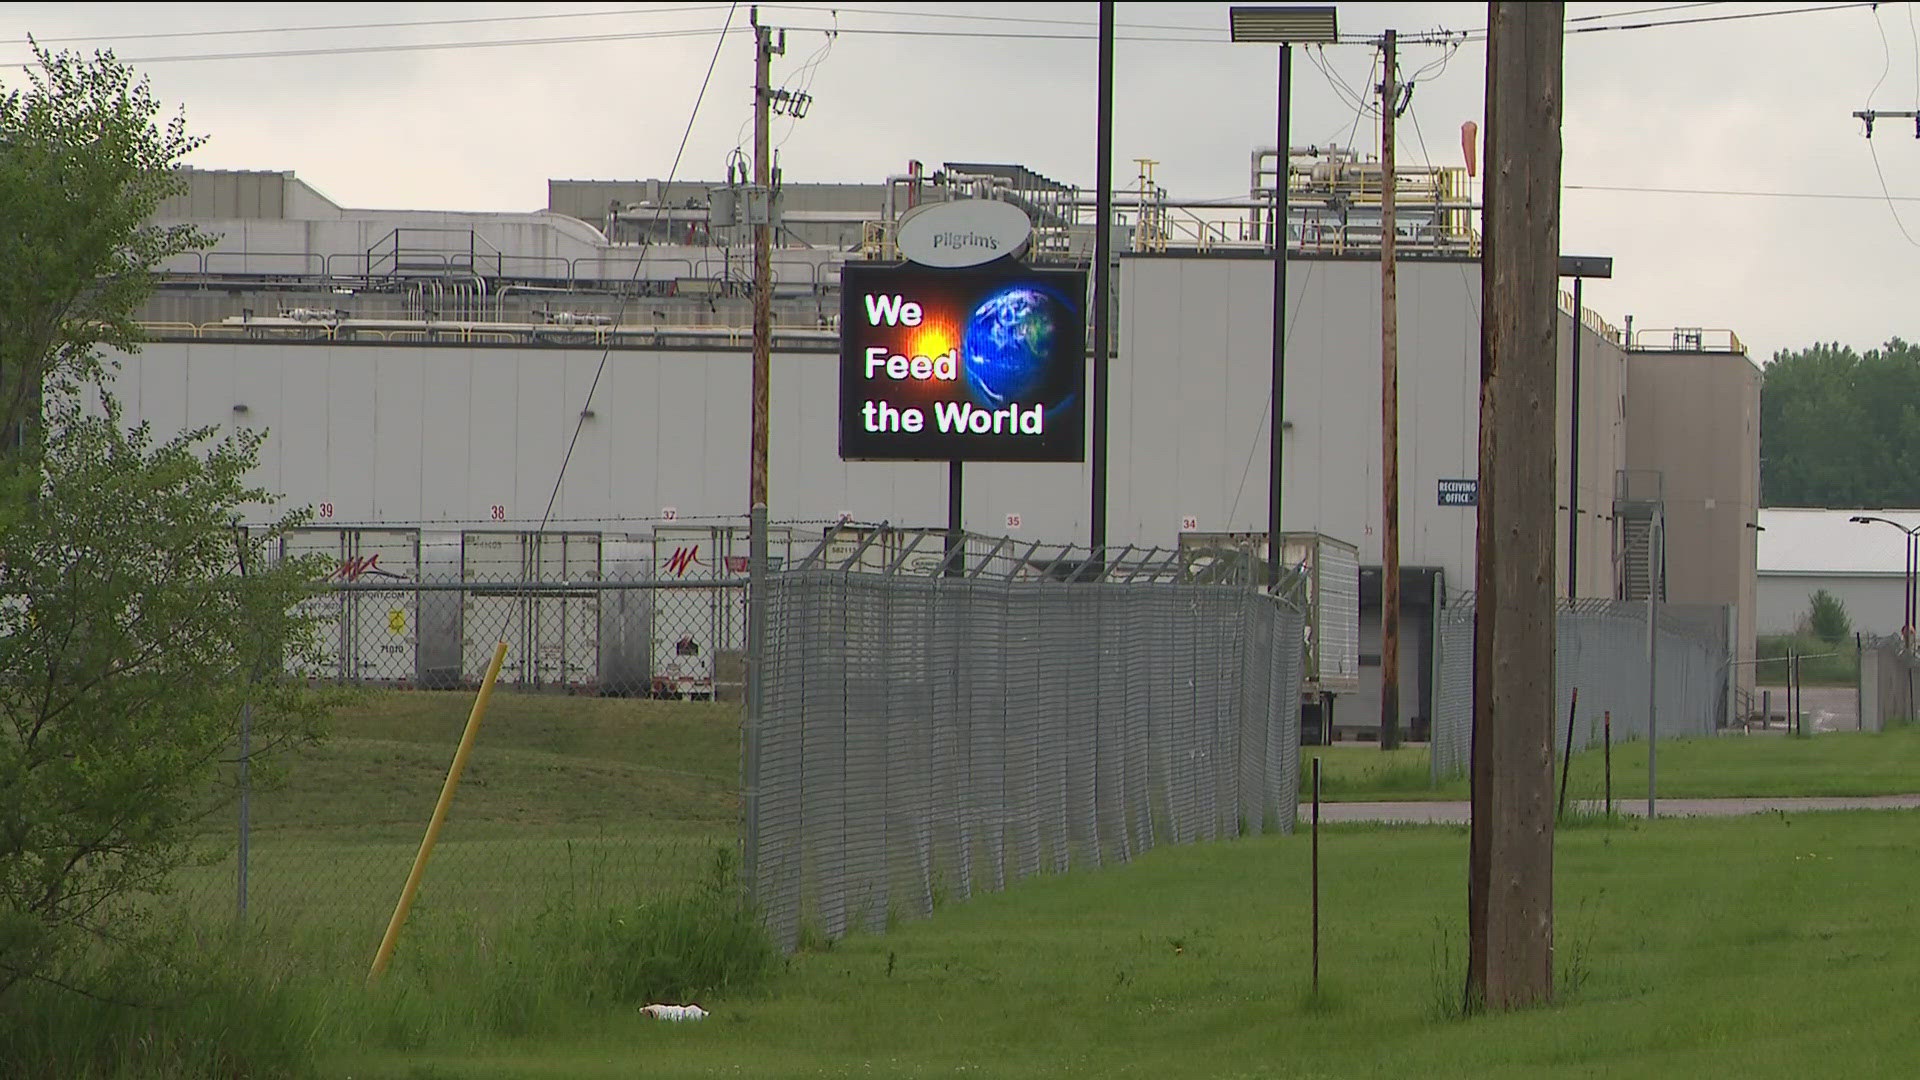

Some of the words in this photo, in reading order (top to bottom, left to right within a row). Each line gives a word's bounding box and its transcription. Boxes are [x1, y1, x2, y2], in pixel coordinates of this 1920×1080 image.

[864, 294, 923, 327] We
[864, 347, 957, 381] Feed
[862, 401, 924, 433] the
[933, 402, 1043, 435] World
[1439, 482, 1476, 492] RECEIVING
[1445, 493, 1469, 503] OFFICE
[319, 503, 333, 518] 39
[491, 505, 505, 520] 38
[663, 511, 676, 520] 37
[1007, 516, 1020, 526] 35
[1183, 519, 1196, 529] 34
